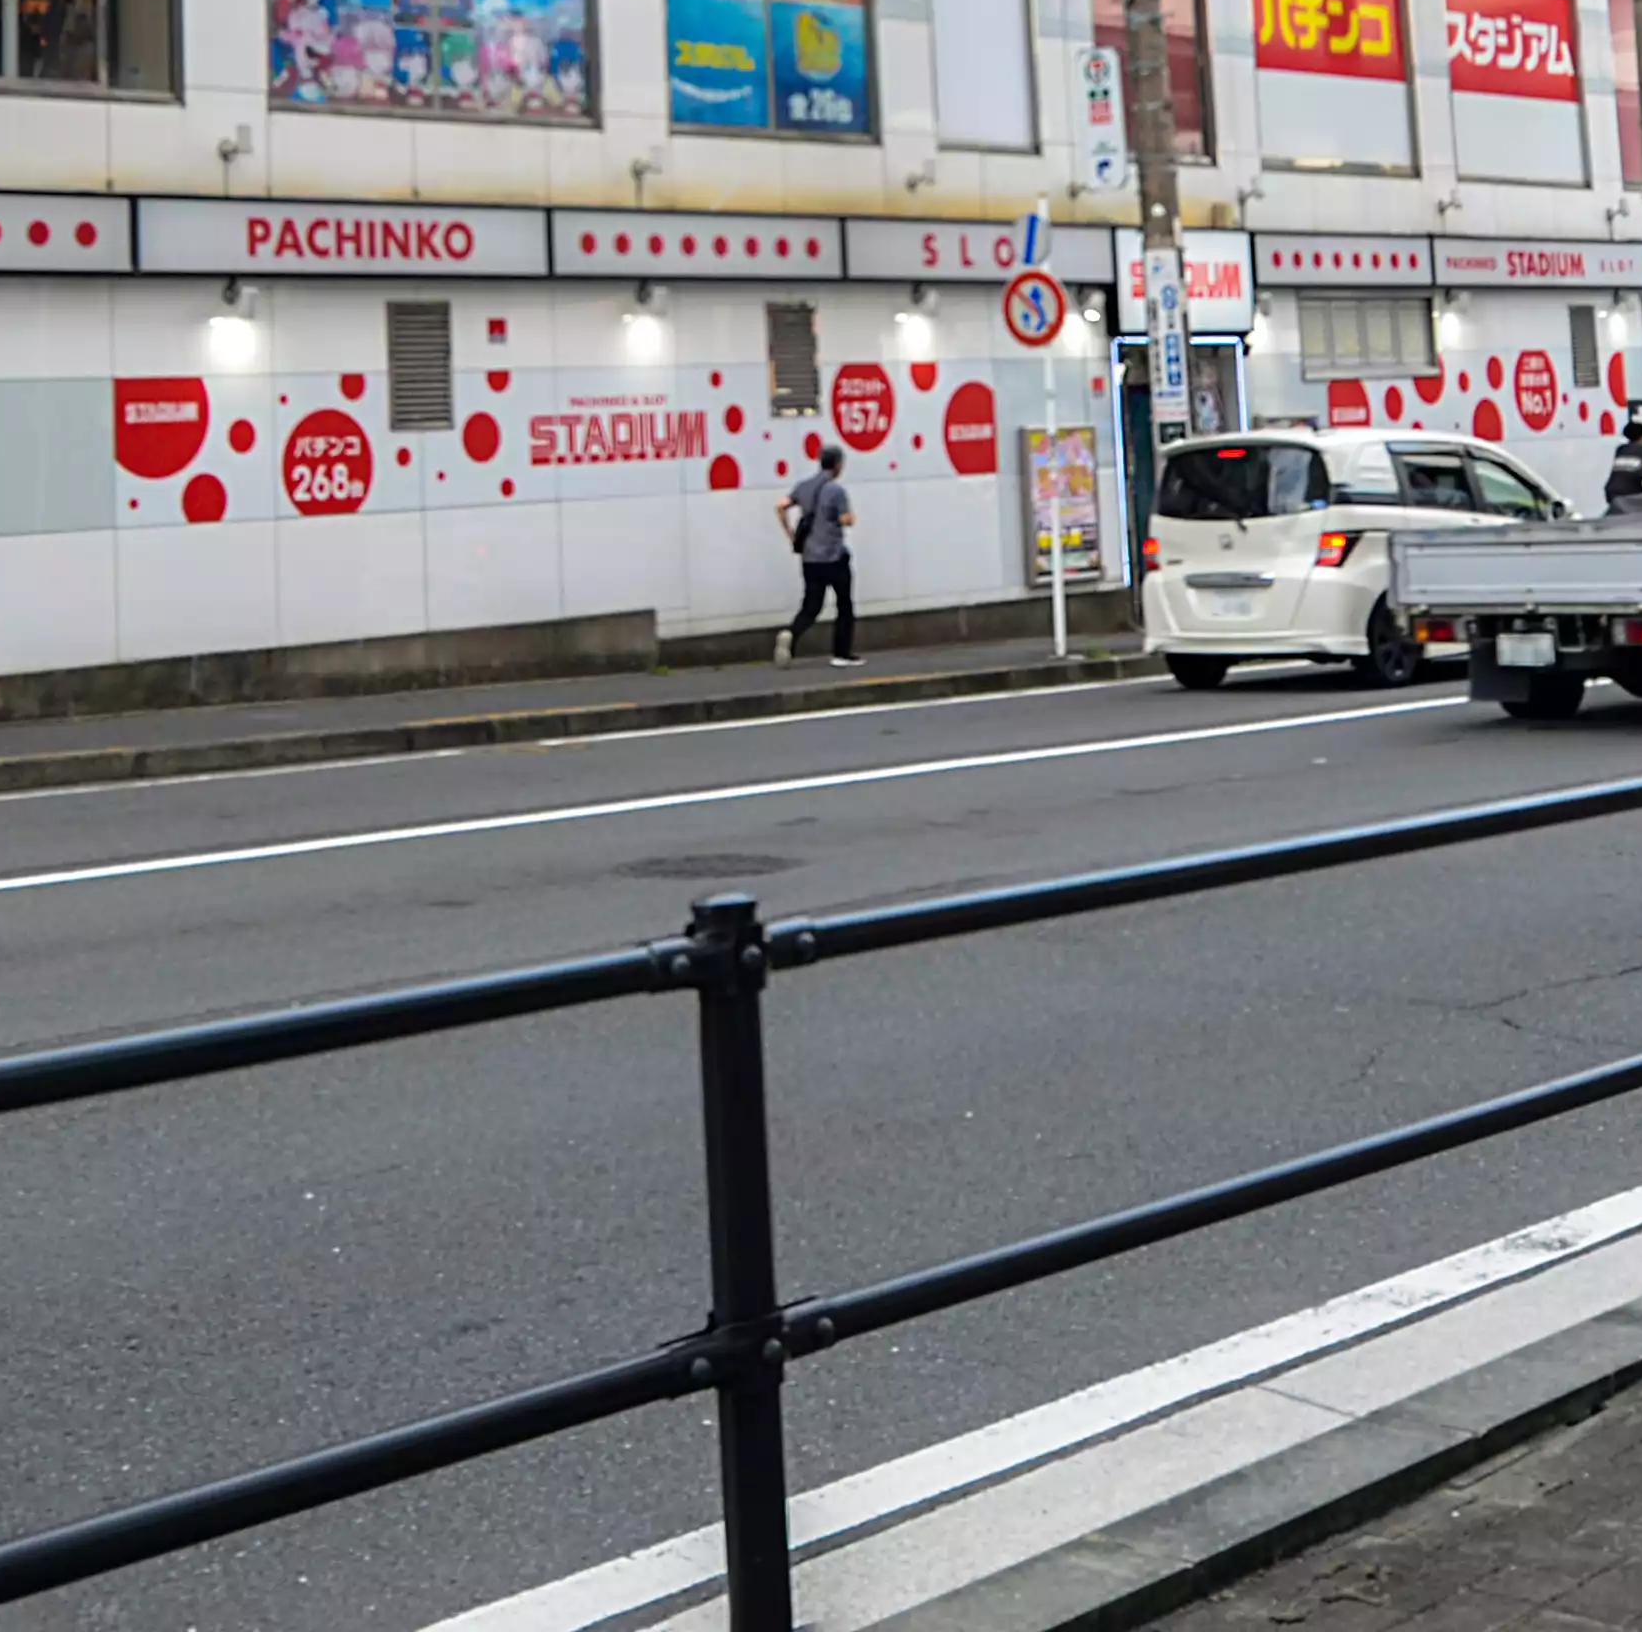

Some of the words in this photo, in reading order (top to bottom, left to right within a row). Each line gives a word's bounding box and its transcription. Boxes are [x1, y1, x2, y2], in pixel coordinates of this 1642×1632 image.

[1445, 11, 1575, 77] スタジアム
[245, 216, 475, 262] PACHINKO
[921, 232, 1017, 270] SLO
[1506, 251, 1586, 278] STADIUM
[293, 436, 362, 458] パチンコ
[529, 411, 708, 466] STADIUM
